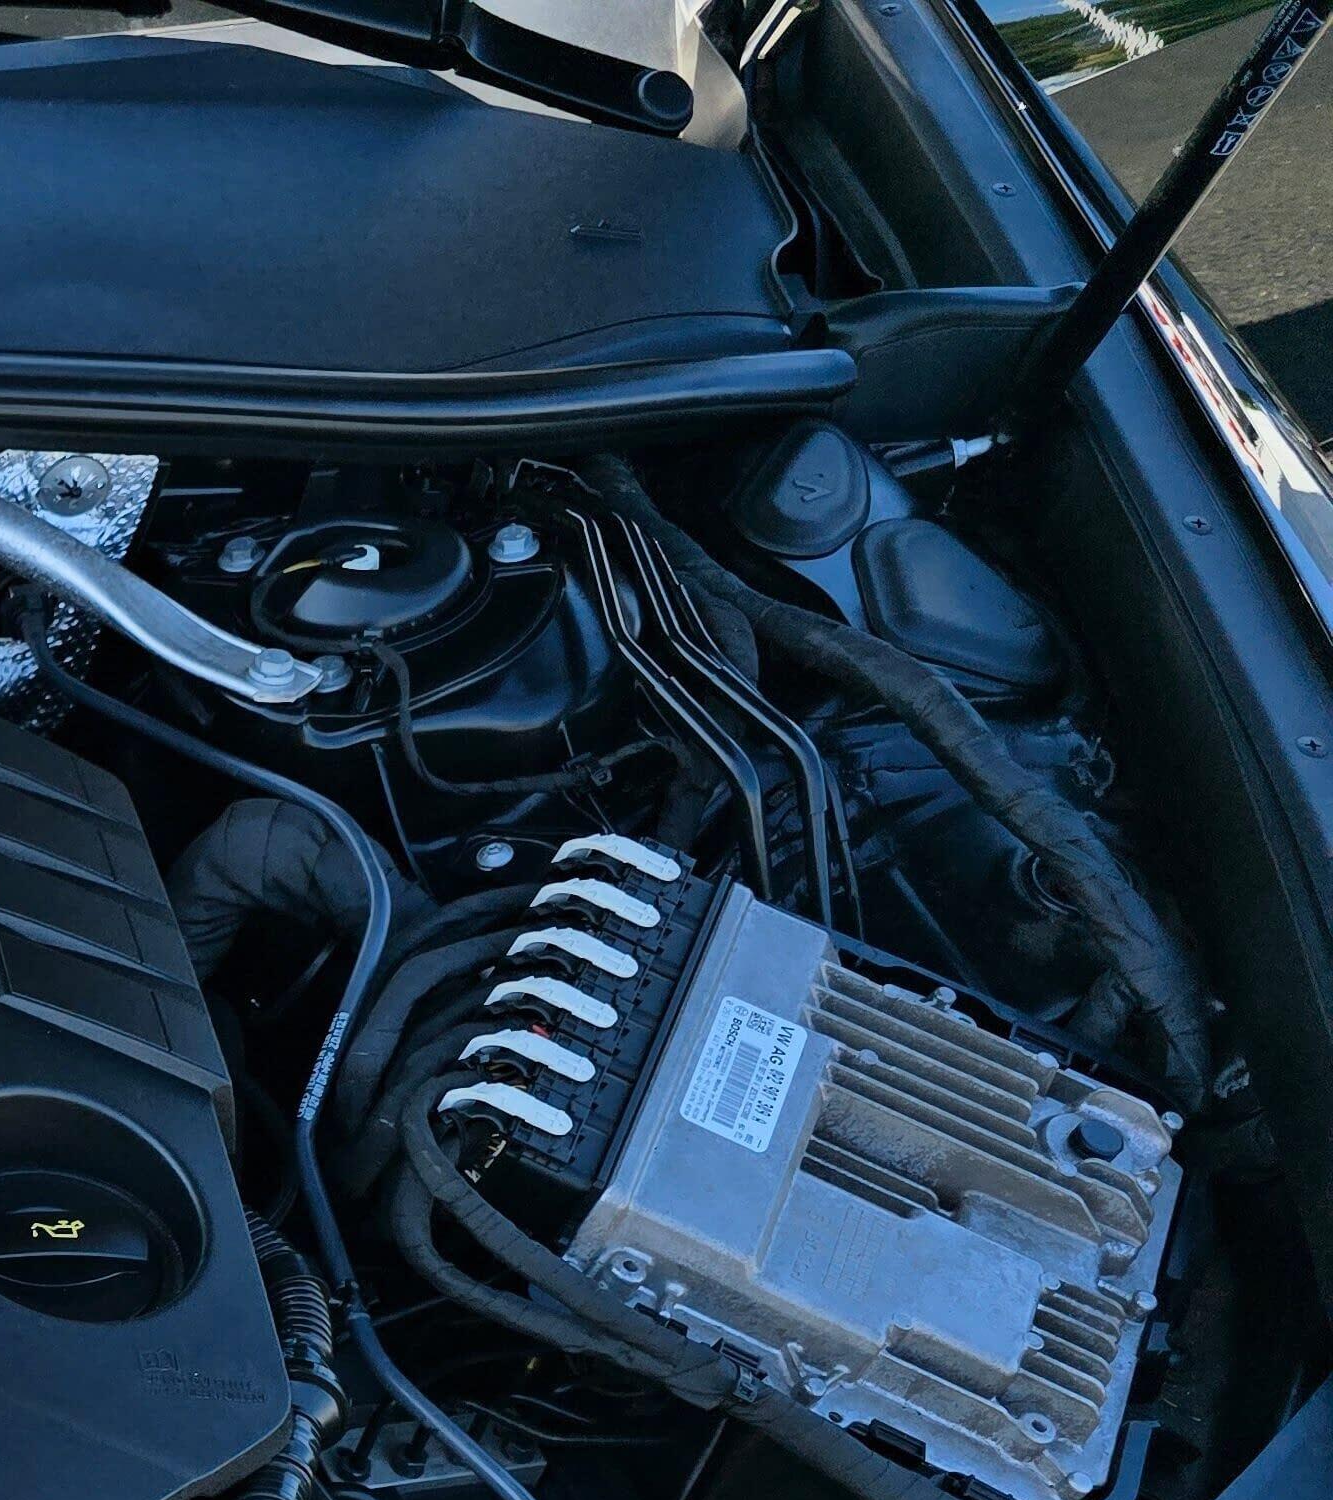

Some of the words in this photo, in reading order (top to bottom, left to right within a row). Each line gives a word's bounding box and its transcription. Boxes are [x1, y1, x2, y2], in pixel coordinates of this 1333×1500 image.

[725, 1017, 743, 1047] BOSCH
[776, 1026, 795, 1047] VW
[769, 1045, 786, 1066] AG
